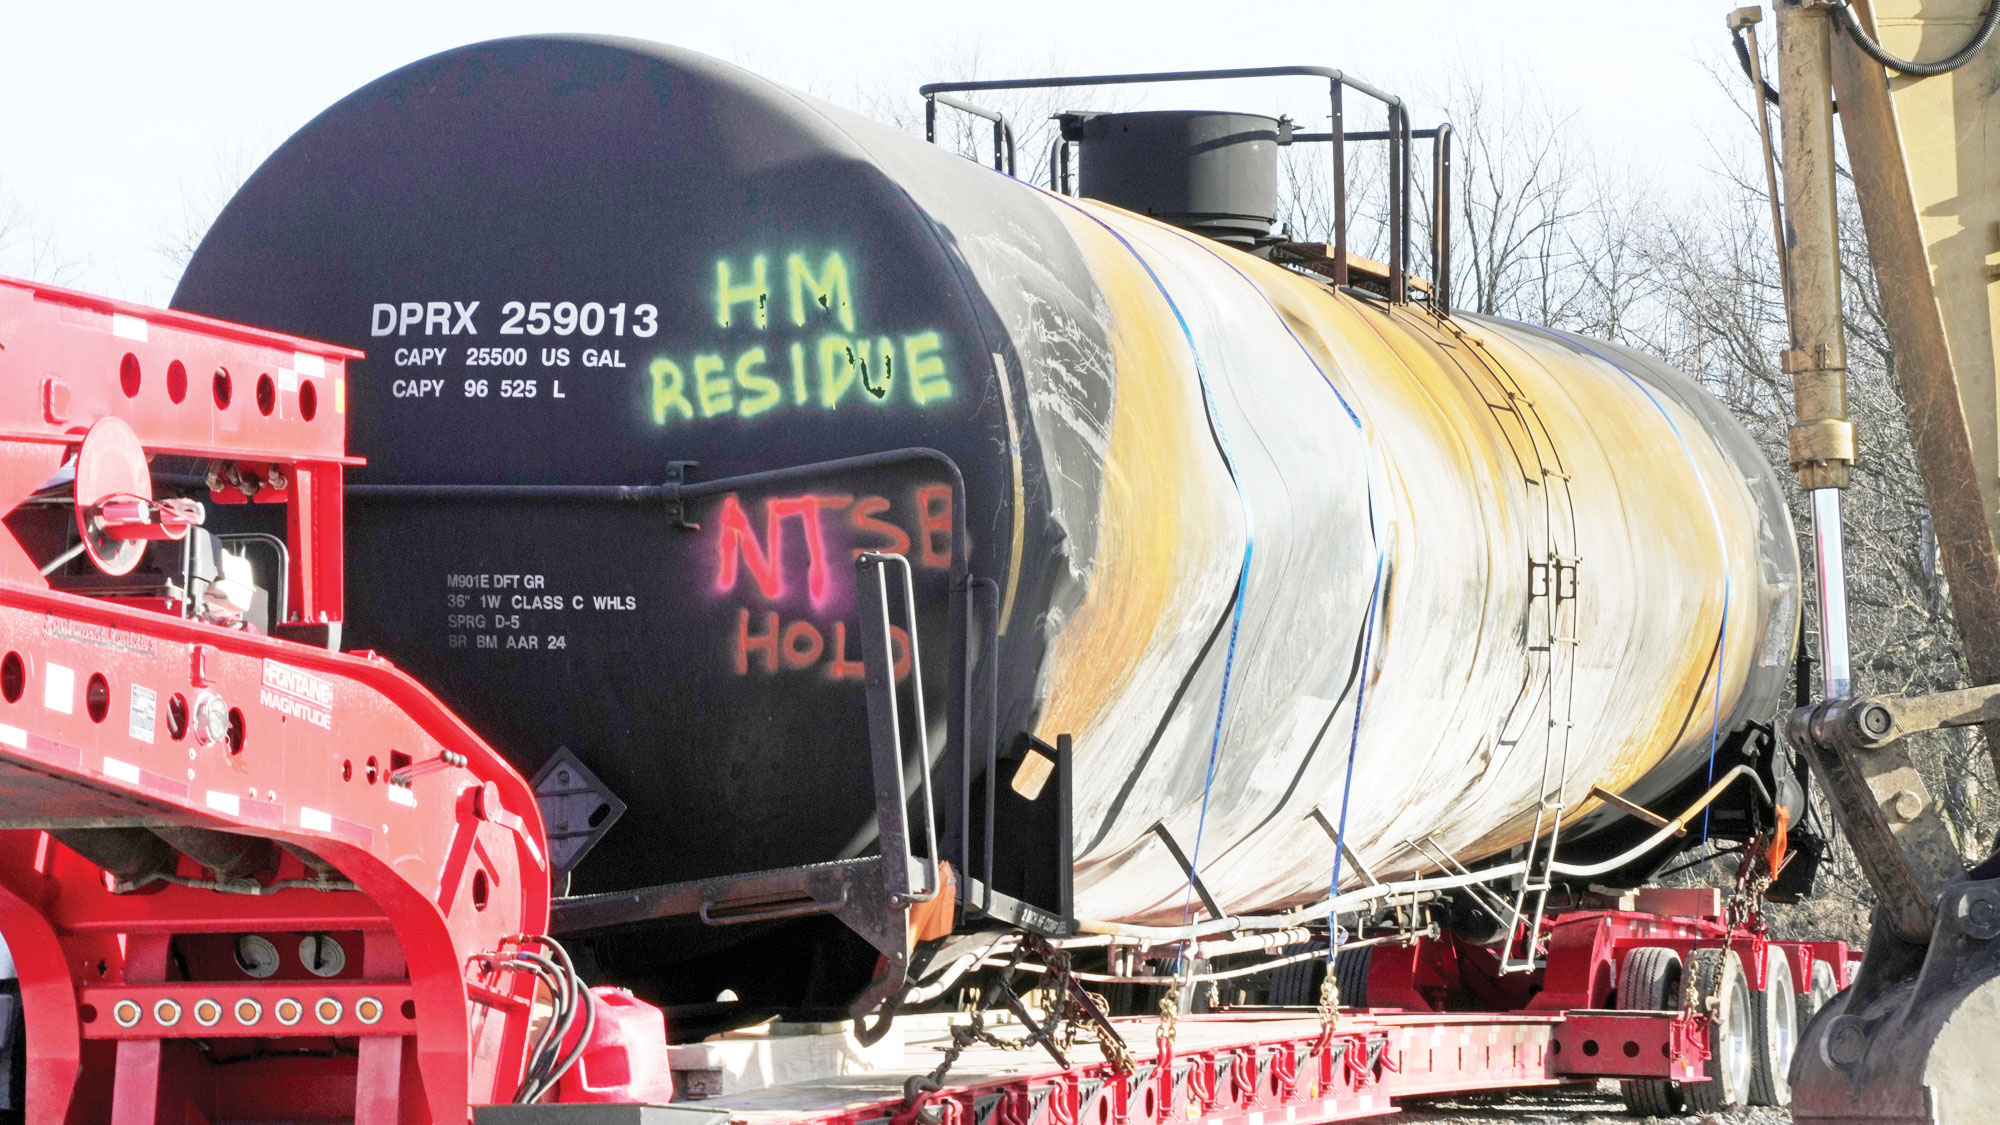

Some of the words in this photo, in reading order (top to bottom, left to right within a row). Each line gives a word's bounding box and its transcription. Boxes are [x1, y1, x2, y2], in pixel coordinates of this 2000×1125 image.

[715, 252, 854, 332] HM
[371, 301, 480, 337] DPRX
[500, 301, 659, 338] 259013
[394, 348, 447, 366] CAPY
[466, 348, 527, 366] 25500
[541, 348, 570, 366] US
[582, 349, 626, 368] GAL
[392, 379, 444, 398] CAPY
[464, 379, 489, 398] 96
[500, 379, 538, 398] 525
[553, 380, 566, 399] L
[649, 331, 953, 426] RESIDUE
[715, 484, 955, 607] NTSB
[447, 574, 489, 588] M901E
[494, 575, 520, 589] DFT
[524, 575, 545, 589] GR
[480, 595, 501, 609] 1W
[511, 595, 564, 610] CLASS
[572, 595, 584, 610] C
[593, 596, 637, 610] WHLS
[448, 615, 486, 628] SPRG
[495, 615, 520, 629] D-5
[450, 635, 467, 648] BR
[476, 635, 498, 649] BM
[506, 636, 539, 650] AAR
[547, 636, 567, 650] 24
[267, 662, 331, 704] FONTAINE
[260, 688, 332, 732] MAGNITUDE
